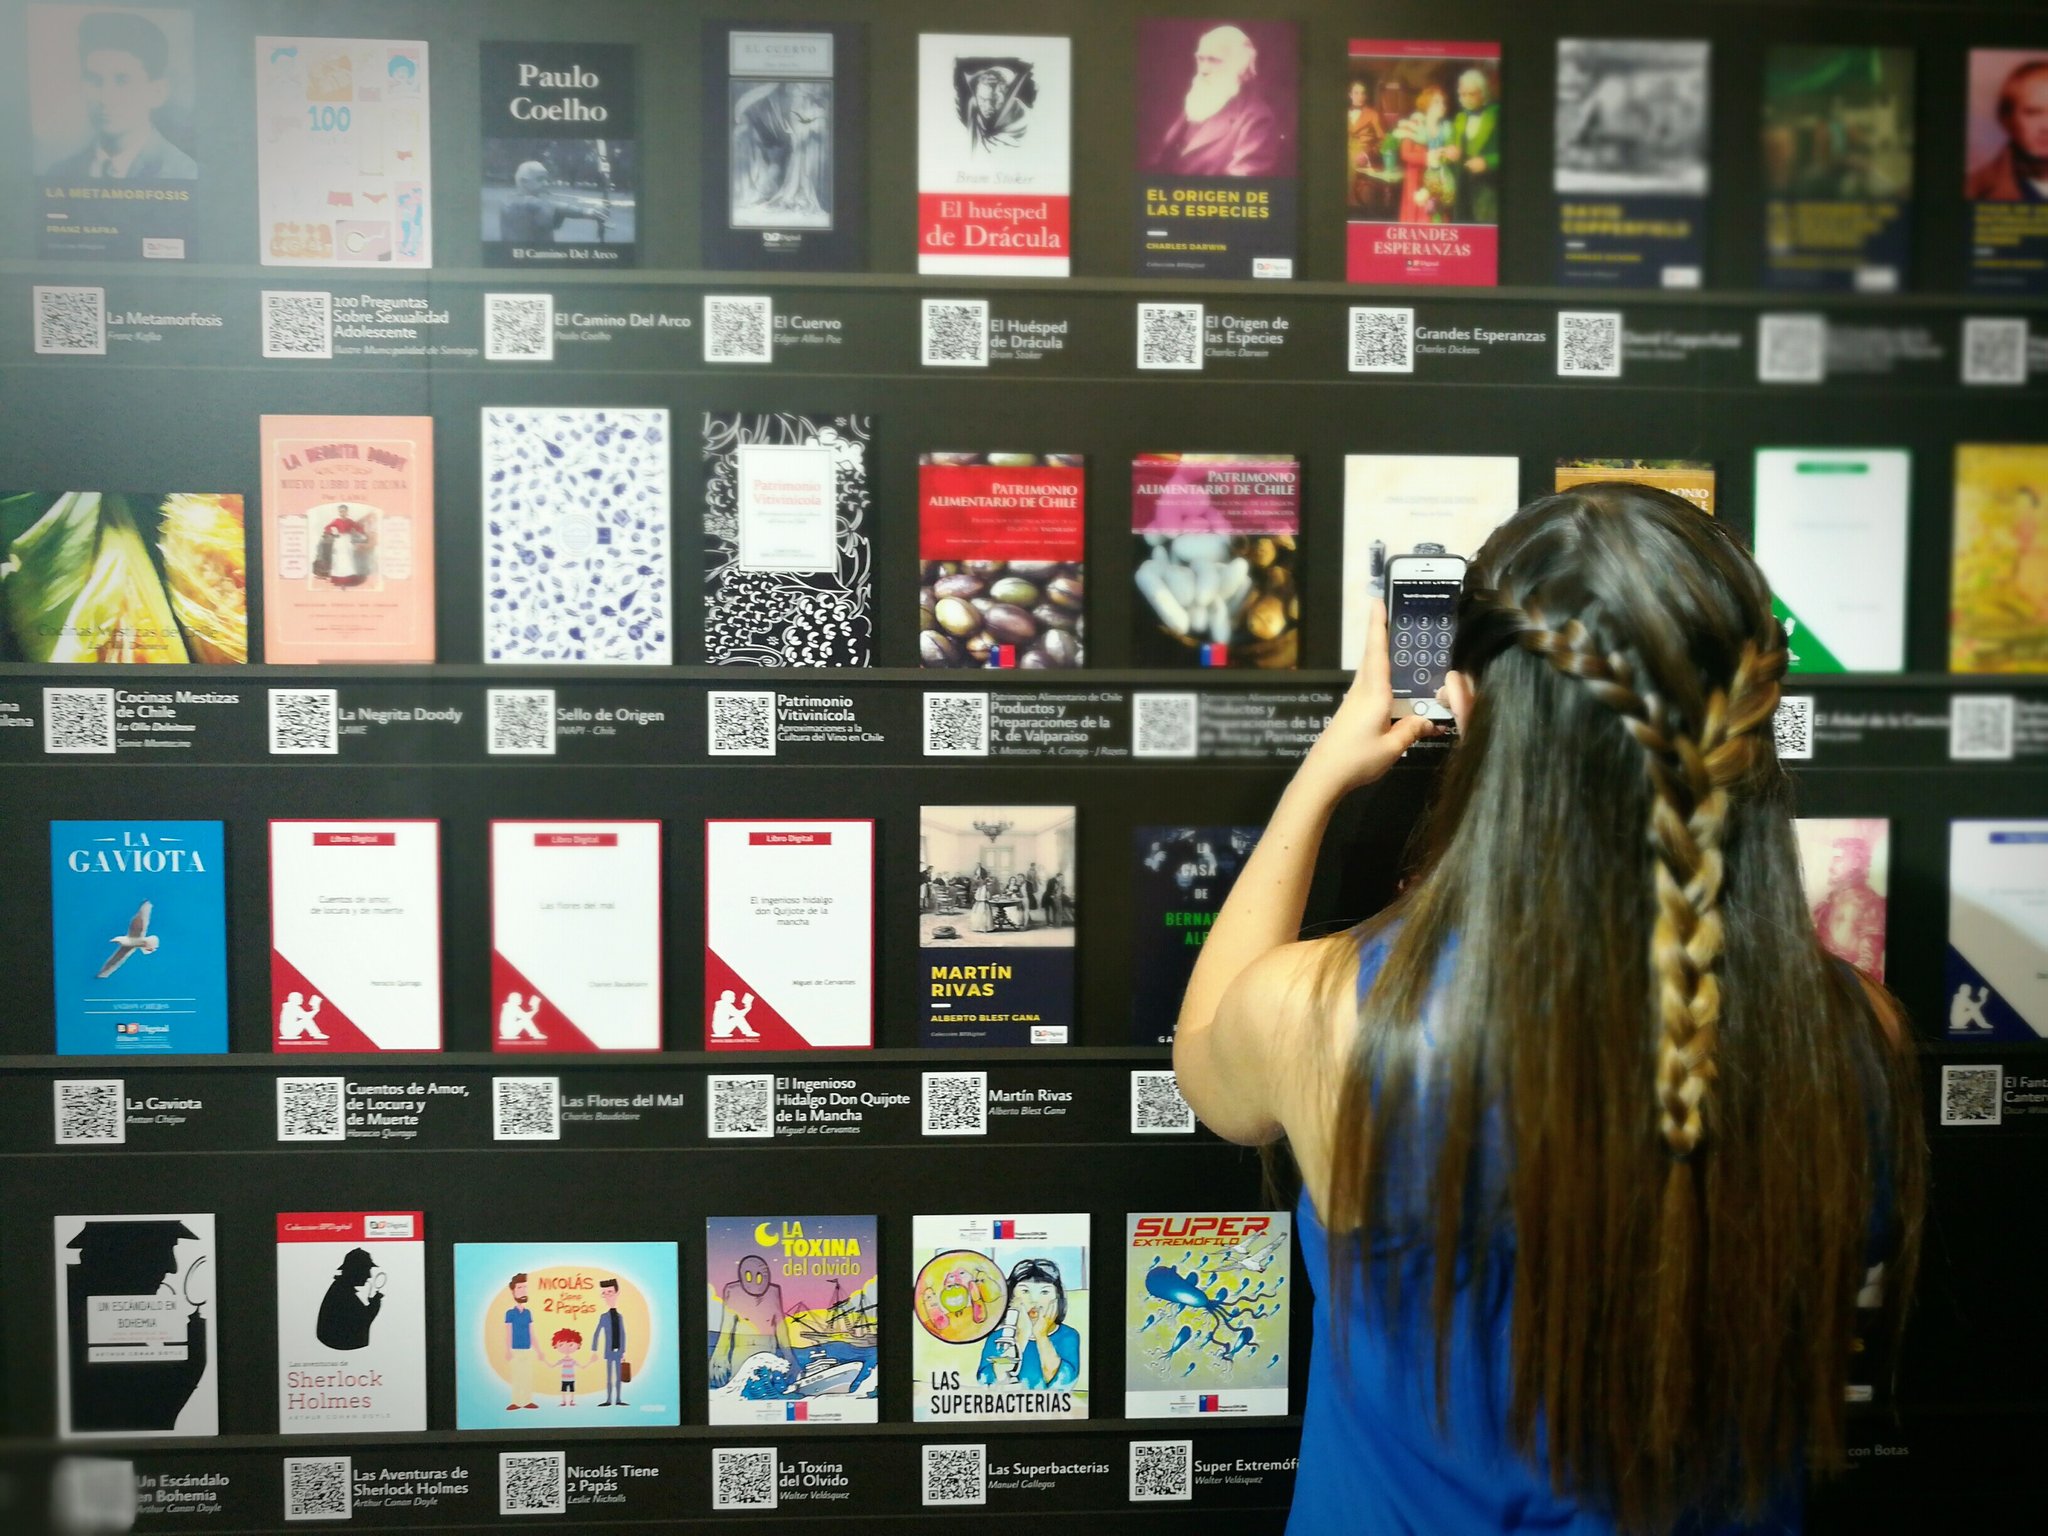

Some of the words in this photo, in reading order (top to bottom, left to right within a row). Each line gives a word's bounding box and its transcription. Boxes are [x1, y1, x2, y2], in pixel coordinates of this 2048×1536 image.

[518, 63, 600, 89] Paulo
[509, 96, 608, 123] Coelho
[307, 105, 352, 133] 100
[45, 187, 65, 199] LA
[69, 188, 190, 202] METAMORFOSIS
[1146, 188, 1167, 202] EL
[1172, 190, 1241, 204] ORIGEN
[1245, 191, 1270, 204] DE
[940, 200, 963, 219] El
[968, 200, 1048, 225] huésped
[1146, 204, 1180, 217] LAS
[1185, 205, 1270, 219] ESPECIES
[925, 223, 956, 247] de
[963, 224, 1062, 249] Drácula
[1386, 227, 1460, 242] GRANDES
[1146, 242, 1188, 251] CHARLES
[1189, 243, 1228, 252] DARWIN
[1373, 241, 1472, 257] ESPERANZAS
[332, 296, 359, 308] 100
[360, 294, 429, 312] Preguntas
[106, 312, 125, 325] La
[126, 312, 224, 327] Metamorfosis
[332, 309, 374, 323] Sobre
[375, 310, 450, 324] Sexualidad
[554, 313, 569, 326] El
[571, 313, 627, 327] Camino
[629, 313, 654, 327] Del
[657, 314, 692, 328] Arco
[1204, 315, 1219, 329] El
[1221, 315, 1269, 333] Origen
[1271, 316, 1290, 330] de
[333, 324, 418, 339] Adolescente
[989, 319, 1004, 333] El
[1007, 319, 1069, 338] Huésped
[1415, 326, 1471, 341] Grandes
[1473, 327, 1547, 345] Esperanzas
[1204, 331, 1224, 343] las
[1226, 331, 1285, 347] Especies
[1207, 470, 1297, 483] PATRIMONIO
[991, 482, 1078, 496] PATRIMONIO
[1136, 483, 1230, 495] ALIMENTARIO
[1233, 484, 1251, 495] DE
[1254, 483, 1296, 496] CHILE
[928, 496, 1018, 508] ALIMENTARIO
[1019, 497, 1037, 508] DE
[1038, 495, 1079, 508] CHILE
[115, 690, 174, 704] Cocinas
[175, 690, 240, 704] Mestizas
[777, 694, 854, 707] Patrimonio
[115, 705, 136, 718] de
[136, 705, 177, 718] Chile
[338, 707, 356, 721] La
[358, 707, 412, 724] Negrita
[413, 707, 464, 724] Doody
[556, 707, 593, 721] Sello
[594, 707, 614, 721] de
[615, 707, 665, 725] Origen
[776, 708, 856, 721] Vitivinícola
[990, 701, 1056, 715] Productos
[1056, 704, 1067, 718] y
[990, 715, 1079, 731] Preparaciones
[1080, 715, 1097, 729] de
[1099, 715, 1111, 729] la
[776, 732, 811, 742] Cultura
[811, 732, 826, 742] del
[826, 732, 848, 742] Vino
[848, 734, 861, 742] en
[861, 732, 885, 742] Chile
[122, 831, 151, 847] LA
[67, 849, 207, 873] GAVIOTA
[1181, 863, 1217, 877] CASA
[1193, 888, 1209, 900] DE
[930, 962, 1013, 980] MARTÍN
[930, 983, 996, 998] RIVAS
[930, 1014, 978, 1023] ALBERTO
[978, 1014, 1011, 1022] BLEST
[1011, 1014, 1041, 1022] GANA
[345, 1082, 406, 1096] Cuentos
[406, 1082, 427, 1096] de
[427, 1082, 470, 1097] Amor,
[775, 1077, 790, 1090] El
[791, 1077, 857, 1094] Ingenioso
[2003, 1076, 2018, 1088] El
[561, 1094, 585, 1108] Las
[586, 1094, 631, 1108] Flores
[631, 1093, 654, 1107] del
[656, 1093, 684, 1107] Mal
[775, 1093, 828, 1110] Hidalgo
[829, 1092, 859, 1106] Don
[860, 1092, 911, 1109] Quijote
[987, 1088, 1035, 1102] Martín
[1037, 1088, 1073, 1102] Rivas
[125, 1097, 144, 1110] La
[145, 1097, 203, 1110] Gaviota
[345, 1098, 365, 1111] de
[366, 1098, 414, 1111] Locura
[415, 1101, 427, 1114] y
[345, 1113, 365, 1126] de
[366, 1112, 420, 1126] Muerte
[775, 1108, 793, 1122] de
[795, 1109, 807, 1121] la
[809, 1108, 863, 1122] Mancha
[775, 1125, 807, 1137] Miguel
[806, 1125, 818, 1134] de
[819, 1124, 861, 1134] Cervantes
[782, 1220, 804, 1239] LA
[1133, 1216, 1271, 1237] SUPER
[781, 1237, 862, 1257] TOXINA
[1132, 1236, 1241, 1247] EXTREMÓFILO
[782, 1256, 808, 1277] del
[811, 1256, 862, 1276] olvido
[537, 1273, 594, 1291] NICOLÁS
[560, 1292, 583, 1301] tiene
[97, 1301, 110, 1312] UN
[165, 1300, 177, 1311] EN
[543, 1298, 554, 1313] 2
[556, 1301, 597, 1321] Papás
[117, 1318, 158, 1329] BOHEMIA
[286, 1369, 383, 1389] Sherlock
[931, 1370, 961, 1392] LAS
[287, 1392, 373, 1410] Holmes
[931, 1392, 1072, 1415] SUPERBACTERIAS
[1847, 1445, 1871, 1457] con
[1873, 1443, 1910, 1457] Botas
[353, 1468, 377, 1482] Las
[379, 1467, 449, 1481] Aventuras
[450, 1465, 469, 1479] de
[567, 1466, 619, 1479] Nicolás
[620, 1465, 660, 1478] Tiene
[779, 1462, 796, 1475] La
[799, 1461, 843, 1475] Toxina
[987, 1463, 1011, 1477] Las
[1013, 1462, 1110, 1479] Superbacterias
[1194, 1460, 1233, 1474] Super
[1235, 1458, 1300, 1472] Extremófi
[136, 1475, 158, 1488] Un
[159, 1473, 231, 1488] Escándalo
[567, 1483, 577, 1492] 2
[579, 1480, 619, 1495] Papás
[779, 1475, 800, 1488] del
[802, 1474, 849, 1487] Olvido
[987, 1480, 1020, 1490] Manuel
[1020, 1480, 1056, 1491] Gallegos
[1194, 1475, 1224, 1486] Walter
[137, 1492, 155, 1503] en
[156, 1489, 218, 1503] Bohemia
[353, 1483, 414, 1497] Sherlock
[416, 1481, 470, 1496] Holmes
[779, 1491, 809, 1500] Walter
